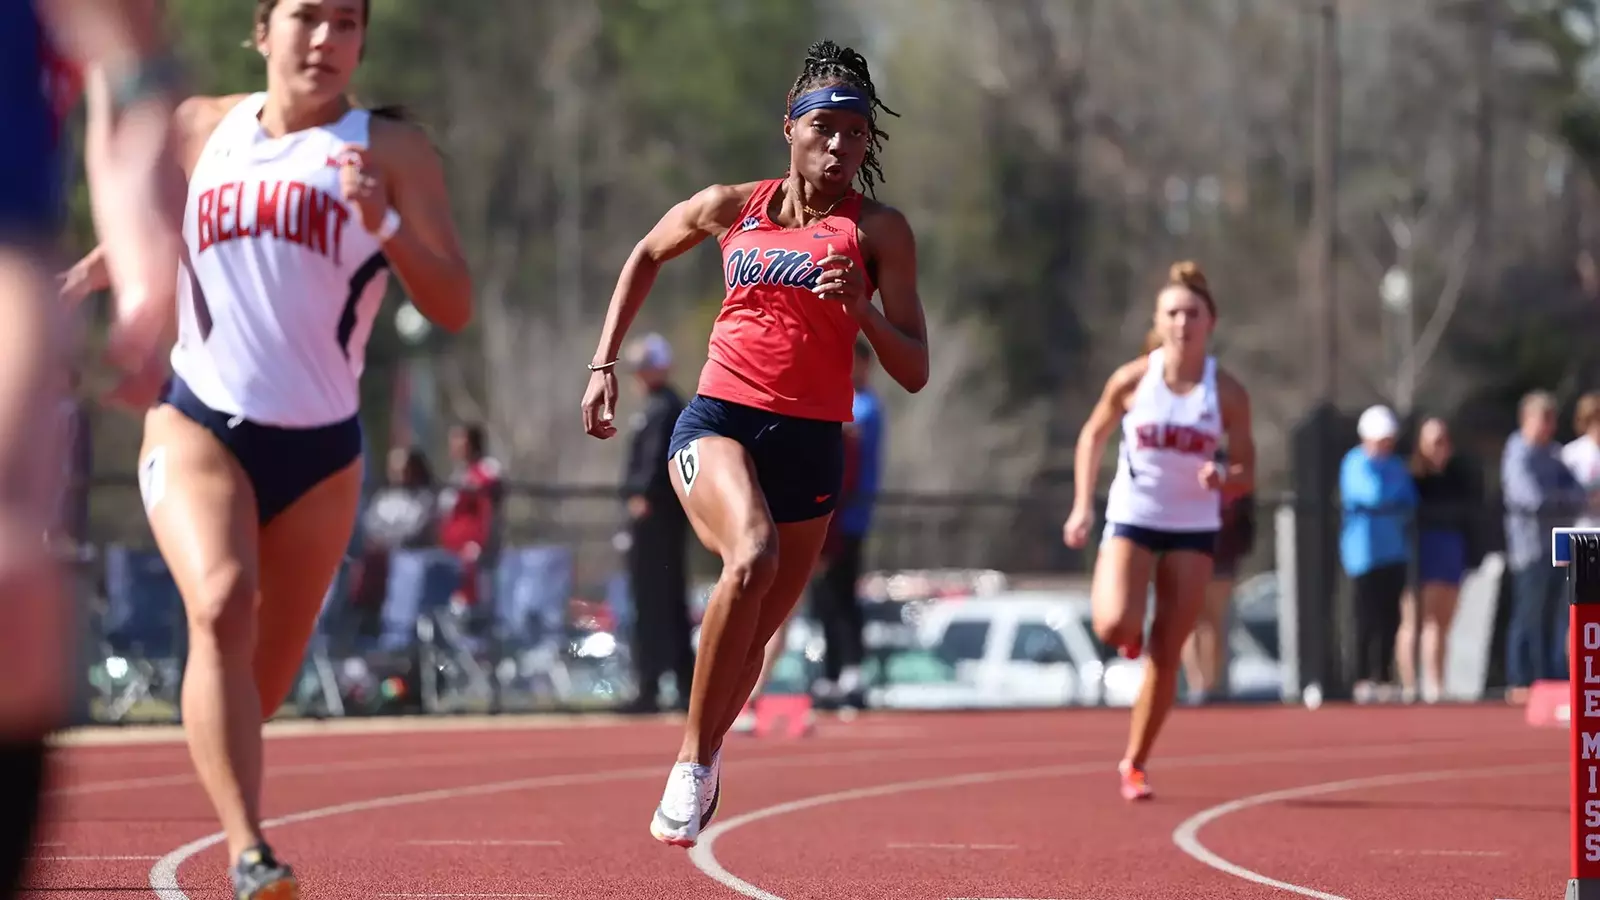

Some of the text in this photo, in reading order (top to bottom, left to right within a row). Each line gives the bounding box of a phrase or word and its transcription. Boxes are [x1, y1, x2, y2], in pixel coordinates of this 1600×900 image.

[197, 180, 349, 267] BELMONT
[726, 248, 826, 291] Ole Mis
[679, 444, 695, 485] 6
[1581, 622, 1600, 862] OLE MISS
